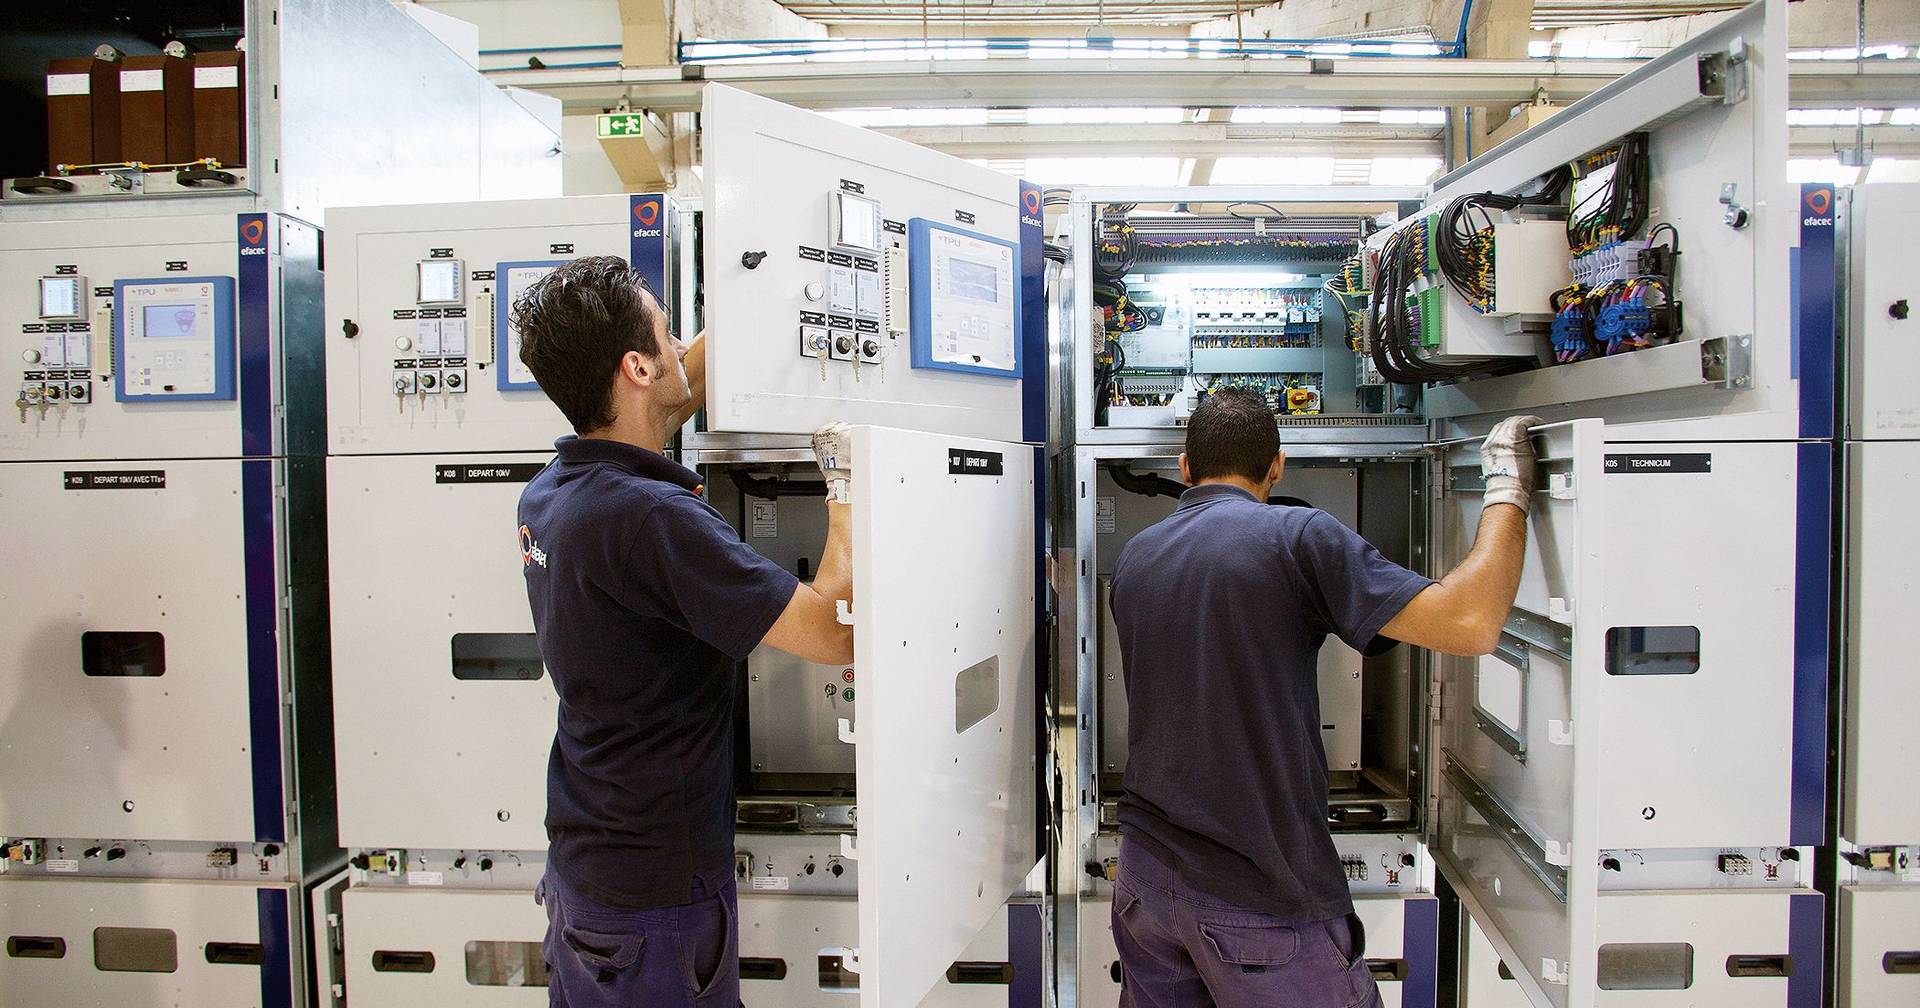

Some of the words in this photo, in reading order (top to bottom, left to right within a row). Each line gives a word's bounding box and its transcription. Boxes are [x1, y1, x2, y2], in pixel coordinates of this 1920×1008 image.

[1021, 215, 1042, 227] efacec
[1804, 217, 1832, 226] efacec
[633, 228, 661, 238] efacec
[240, 246, 266, 256] efacec
[137, 287, 156, 296] TPU
[1631, 459, 1671, 467] TECHNICUM
[468, 469, 495, 478] DEPART
[94, 476, 119, 484] DEPART
[133, 475, 150, 483] AVEC
